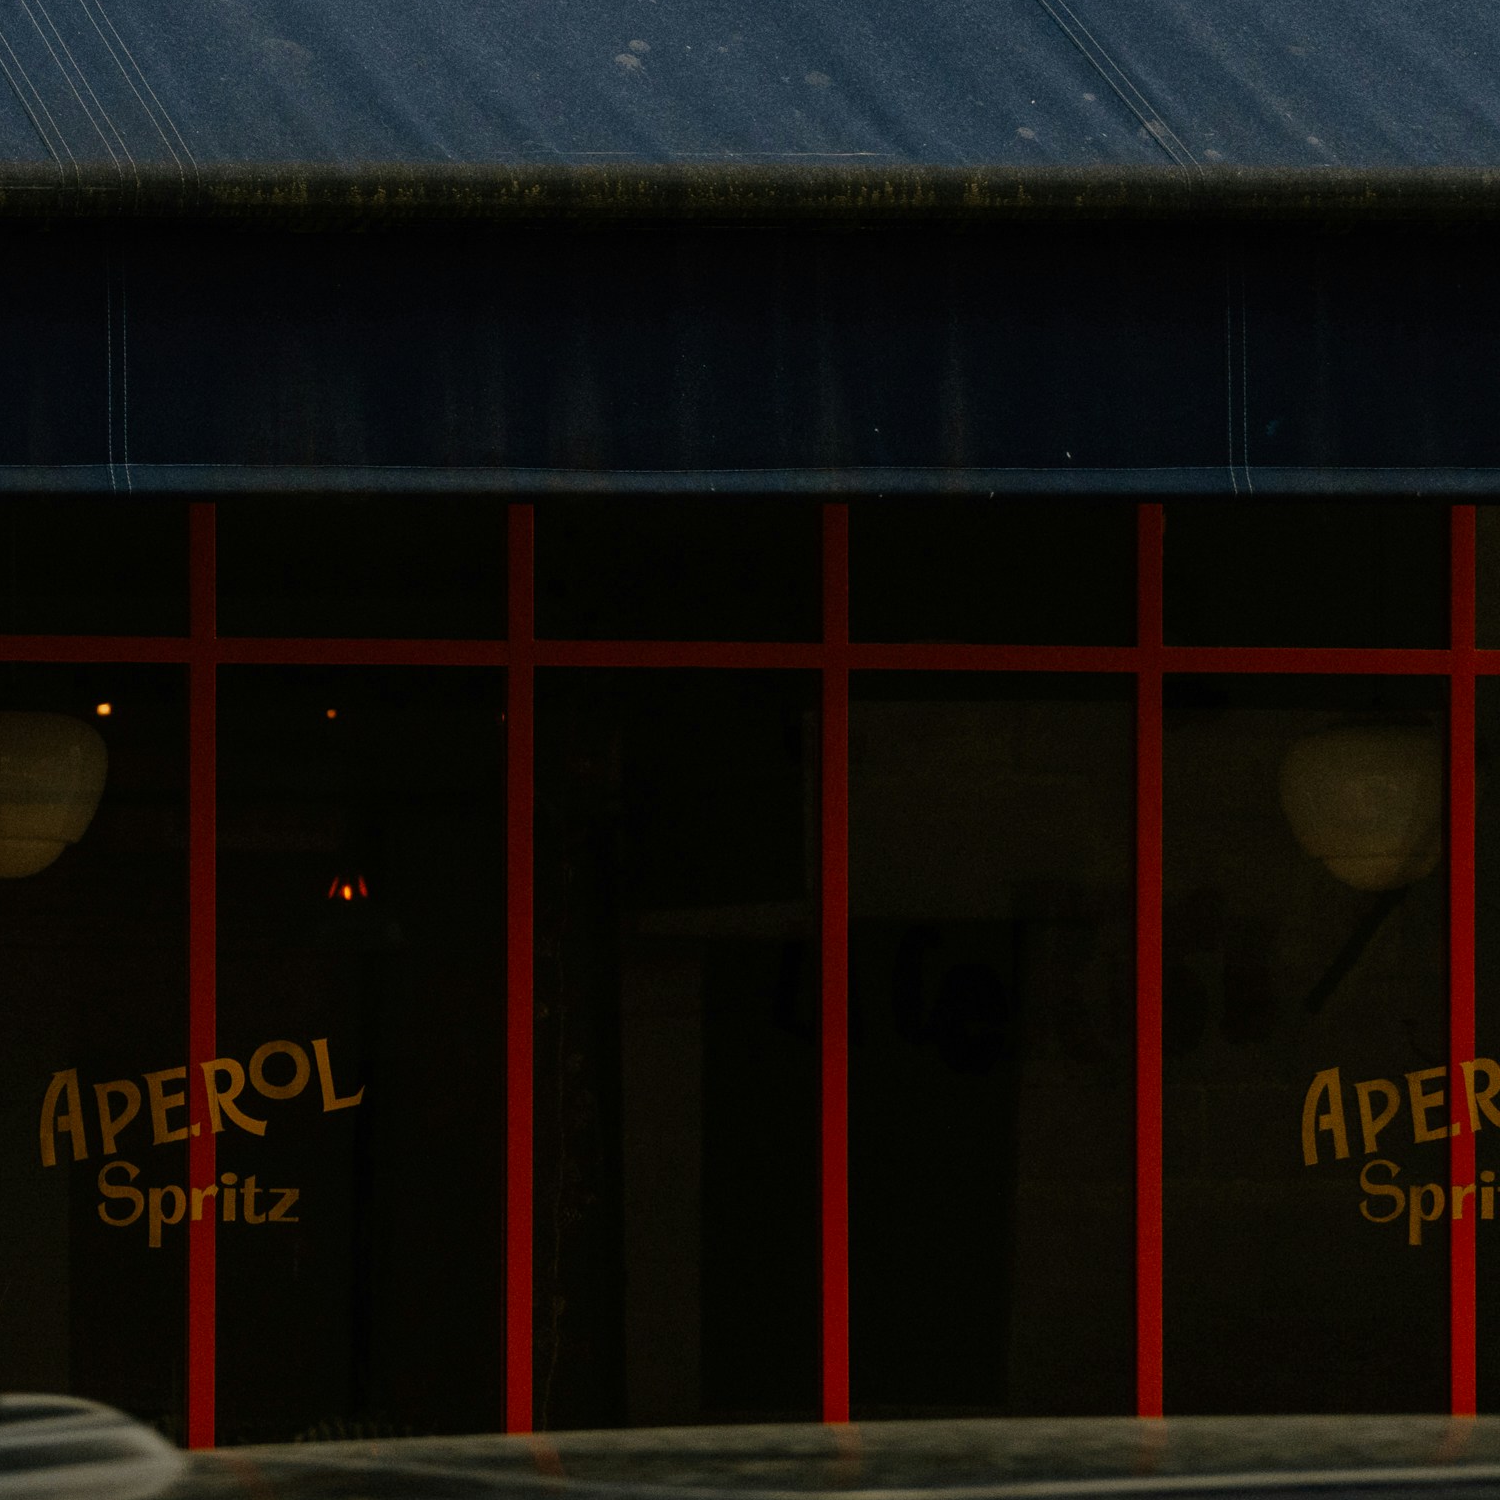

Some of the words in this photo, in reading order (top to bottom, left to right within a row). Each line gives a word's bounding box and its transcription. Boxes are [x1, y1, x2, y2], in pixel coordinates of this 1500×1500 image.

[39, 1038, 366, 1168] APEROL
[97, 1160, 300, 1248] Spritz
[1358, 1158, 1500, 1246] Spri
